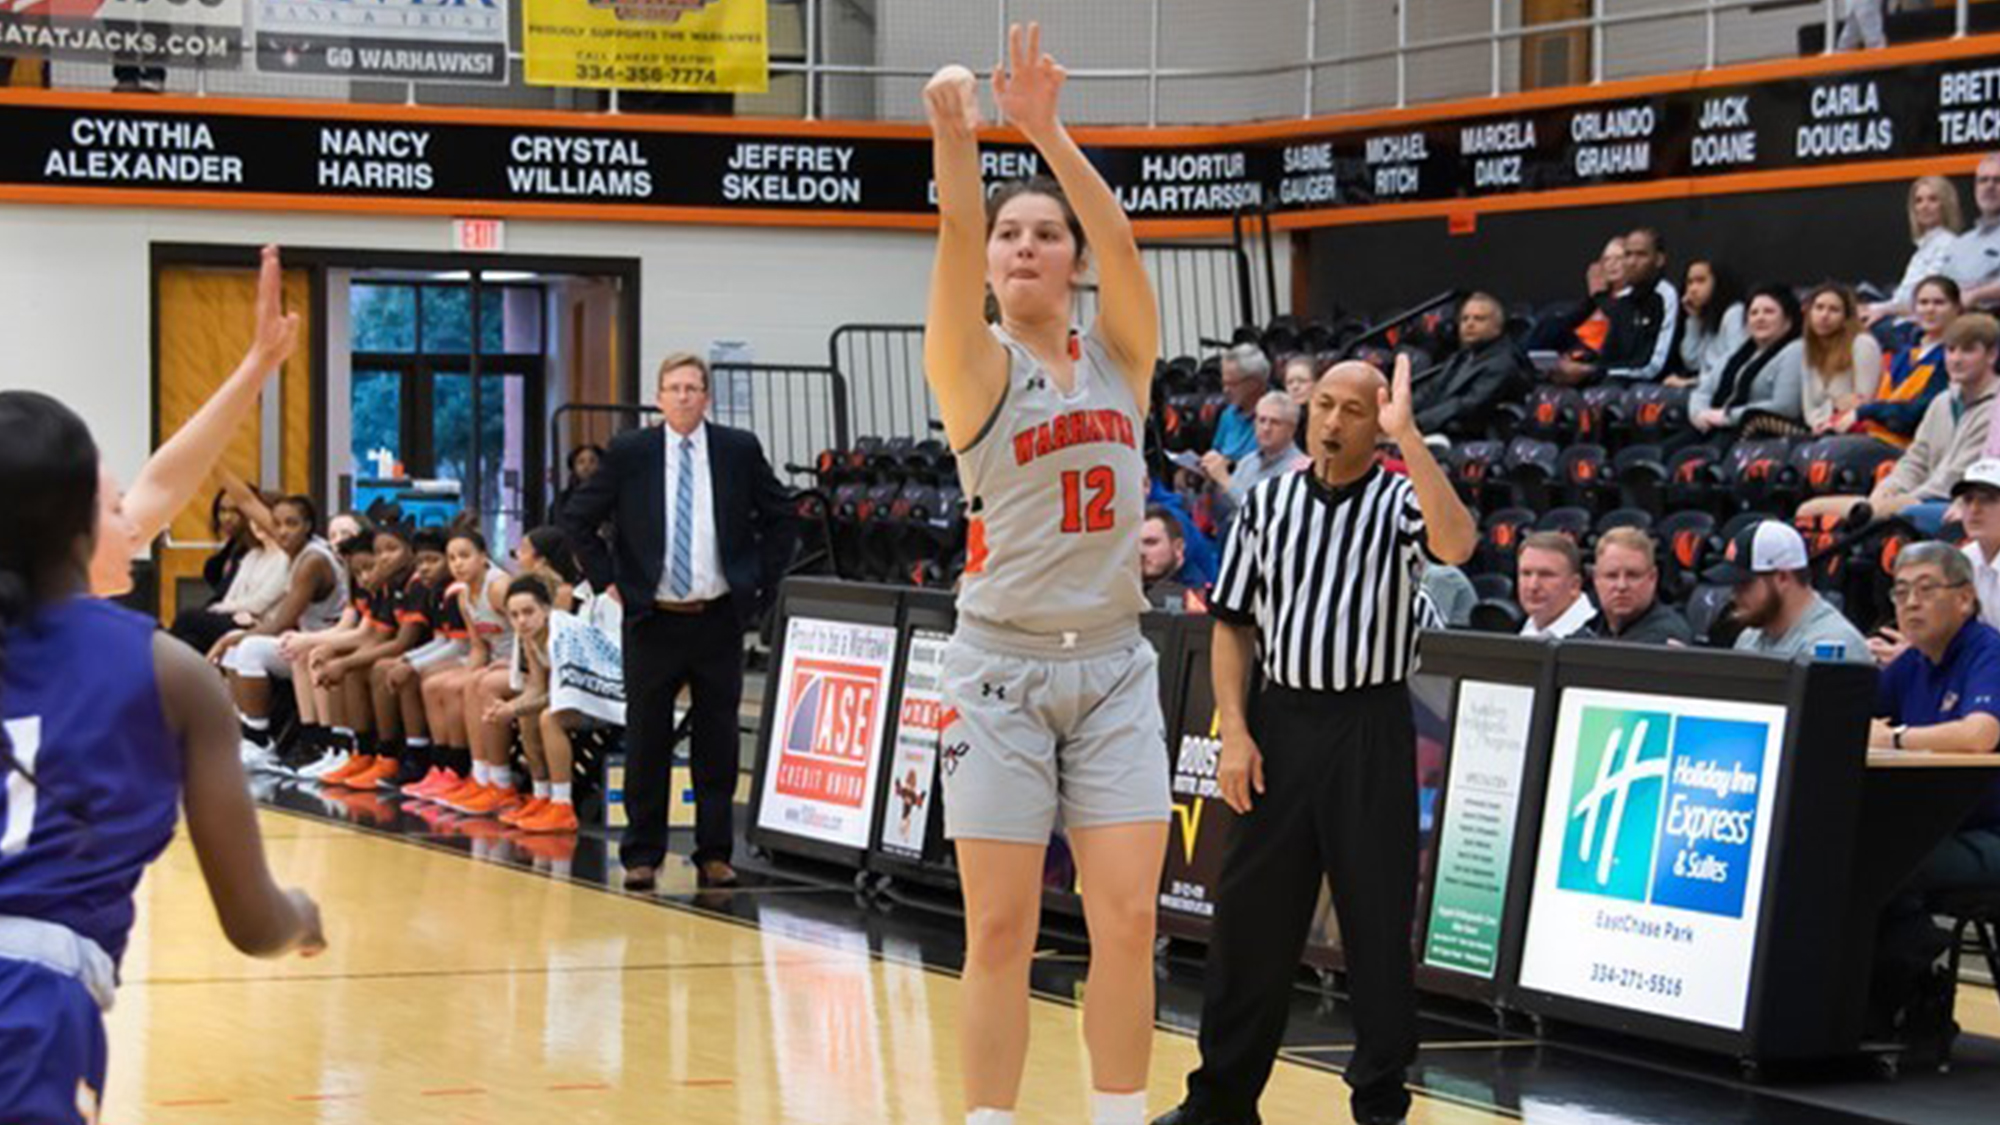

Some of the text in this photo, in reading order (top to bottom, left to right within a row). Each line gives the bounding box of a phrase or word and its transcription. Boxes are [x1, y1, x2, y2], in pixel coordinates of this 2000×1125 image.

[0, 23, 228, 57] ATATJACKS.COM
[528, 25, 585, 37] PROUDLY
[591, 27, 657, 41] SUPPORTS
[662, 30, 686, 42] THE
[325, 47, 495, 73] GO WARHAWKS!
[576, 51, 606, 62] CALL
[615, 53, 660, 64] AHEAD
[1811, 82, 1879, 119] CARLA
[1940, 67, 2000, 106] BRET
[1571, 105, 1655, 142] ORLANDO
[1698, 96, 1750, 129] JACK
[71, 118, 215, 151] CYNTHIA
[319, 128, 431, 159] NANCY
[510, 135, 648, 167] CRYSTAL
[1365, 132, 1429, 164] MICHAEL
[1460, 120, 1537, 155] MARCELA
[1691, 131, 1756, 168] DOANE
[1796, 119, 1893, 157] DOUGLAS
[44, 150, 244, 183] ALEXANDER
[728, 143, 854, 173] JEFFREY
[1142, 152, 1245, 181] HJORTUR
[1283, 143, 1333, 172] SABINE
[1474, 156, 1522, 187] DAICZ
[1576, 142, 1650, 177] GRAHAM
[318, 158, 435, 191] HARRIS
[507, 166, 653, 198] WILLIAMS
[722, 174, 861, 203] SKELDON
[1279, 174, 1336, 204] GAUGER
[1375, 166, 1419, 195] RITCH
[462, 220, 498, 249] EXIT
[1060, 465, 1115, 533] 12
[816, 682, 872, 756] ASE
[779, 763, 822, 790] CREDIT
[1673, 755, 1757, 799] Holiday Inn
[1667, 794, 1752, 848] Express
[1673, 850, 1729, 882] & Suites
[1596, 909, 1694, 943] EastChase Park
[1590, 962, 1682, 997] 334-271-5516
